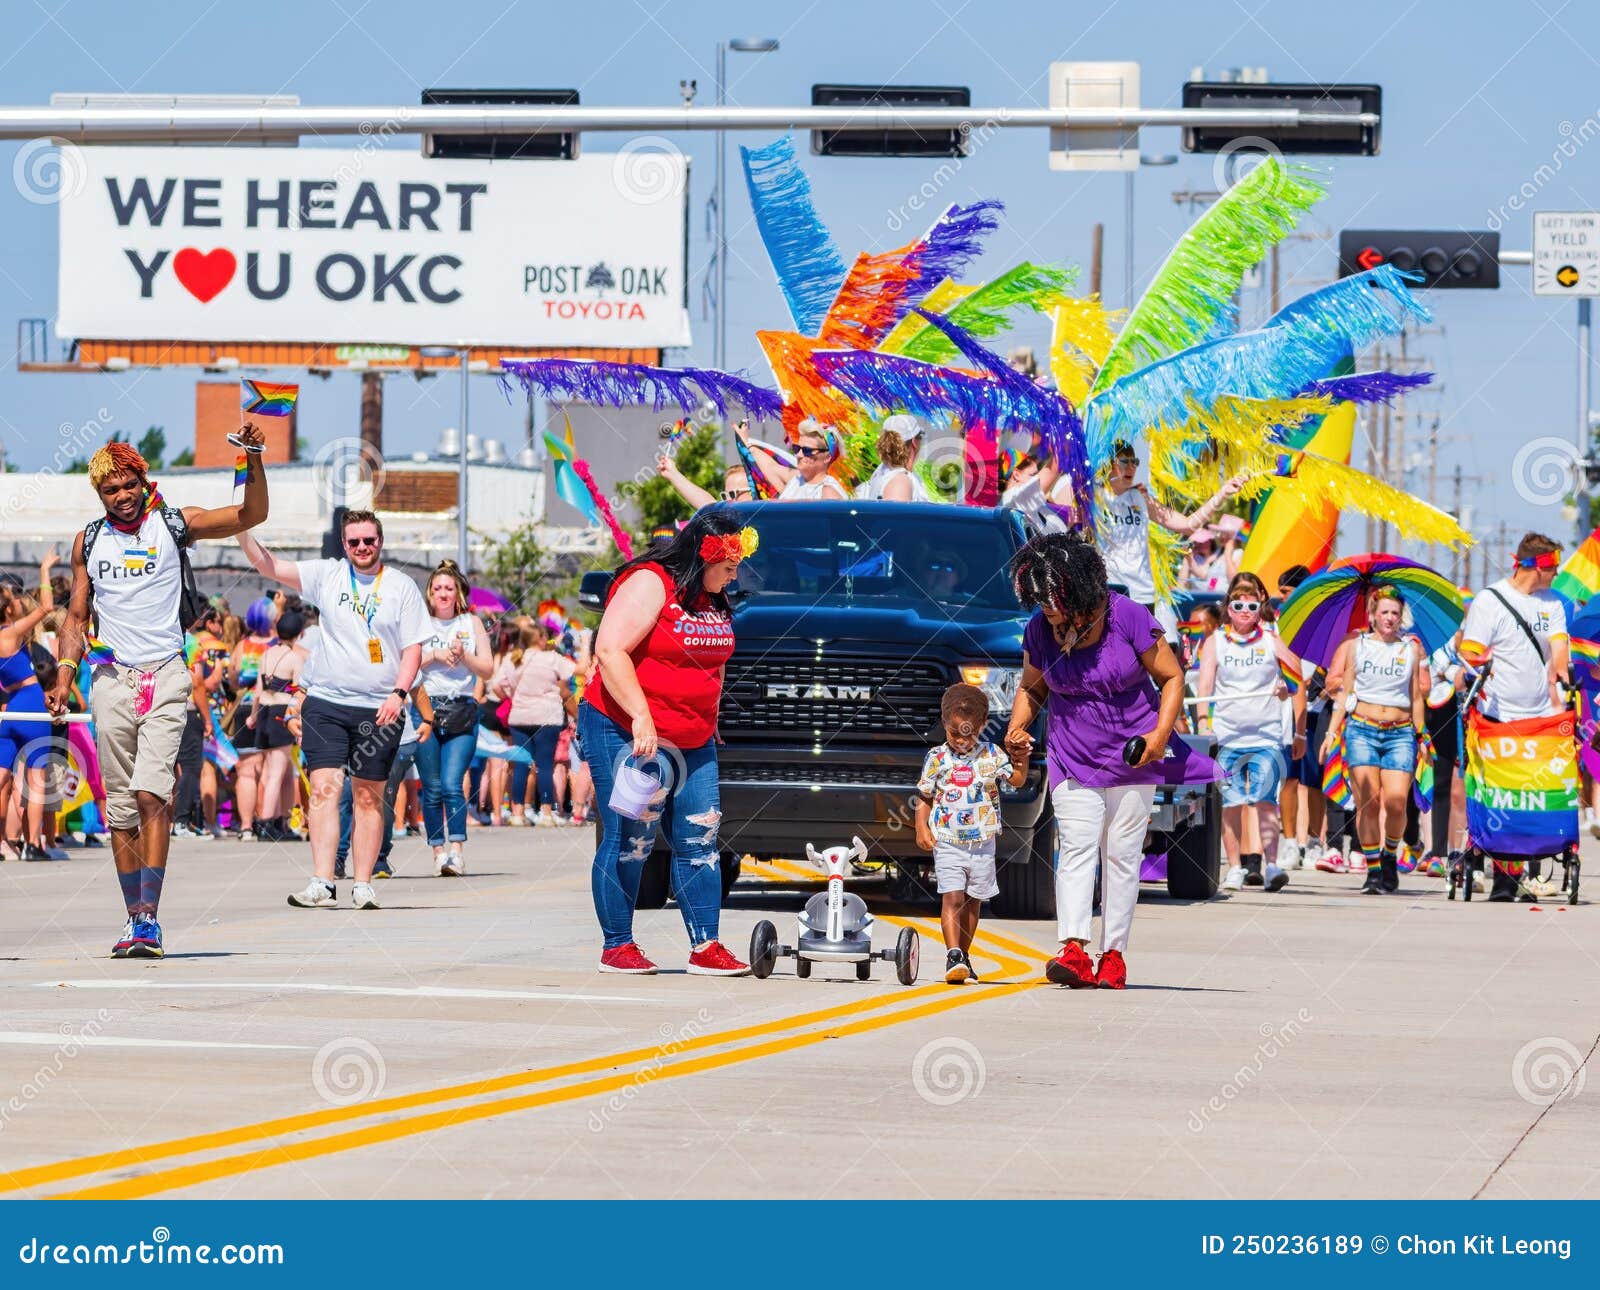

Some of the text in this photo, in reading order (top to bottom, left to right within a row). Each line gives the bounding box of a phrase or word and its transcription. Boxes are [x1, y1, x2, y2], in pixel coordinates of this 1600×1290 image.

[105, 177, 487, 232] WE HEART
[1542, 218, 1594, 228] LEFT TURN
[1551, 232, 1587, 246] YIELD
[315, 253, 464, 304] OKC
[524, 266, 668, 295] POST OAK
[543, 301, 646, 320] TOYOTA
[683, 636, 733, 647] GOVERNOR
[1224, 648, 1264, 667] Pride
[1362, 657, 1403, 677] Pride
[767, 684, 871, 700] RAM
